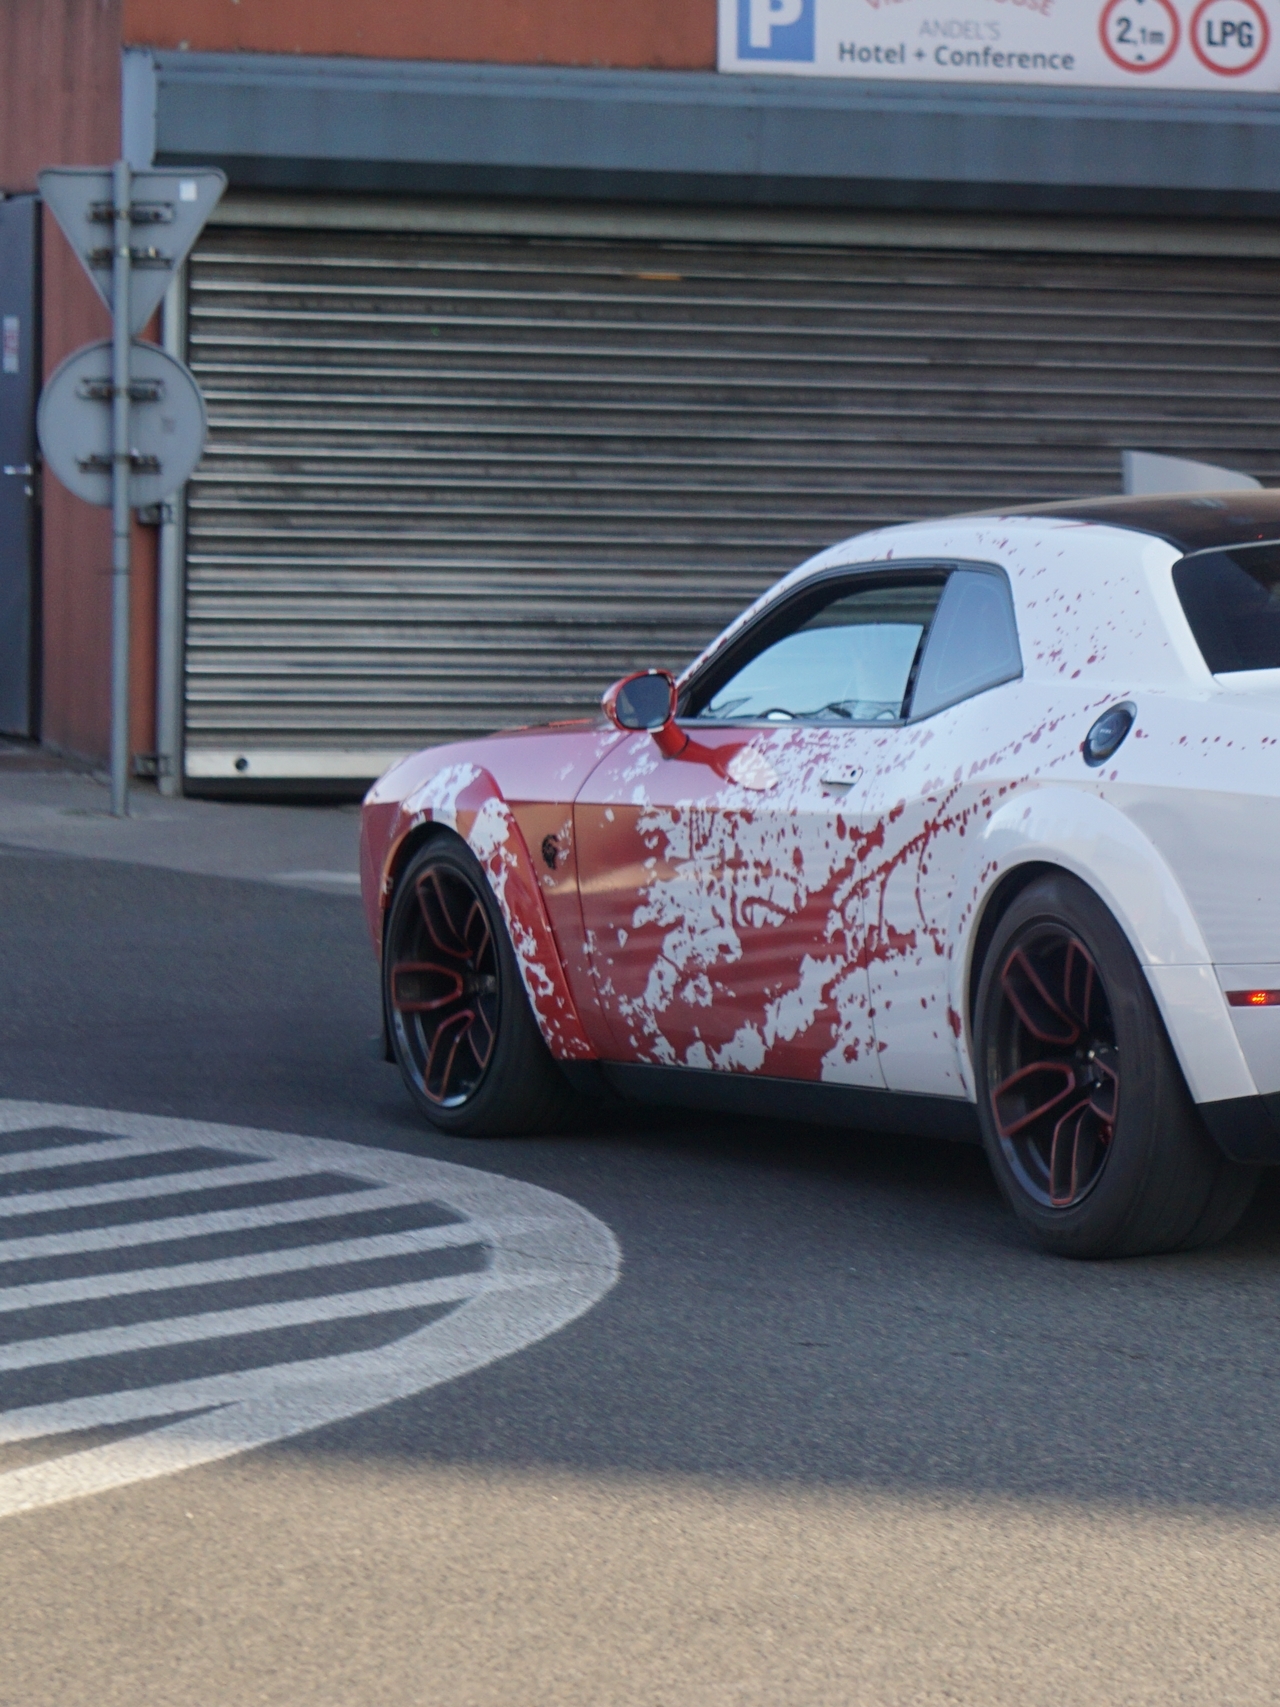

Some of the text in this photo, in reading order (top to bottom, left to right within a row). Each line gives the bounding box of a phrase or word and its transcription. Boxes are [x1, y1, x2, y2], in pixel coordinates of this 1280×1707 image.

[748, 0, 803, 48] P
[919, 19, 1002, 41] ANDEL'S
[1206, 20, 1254, 48] LPG
[838, 42, 1076, 71] Hotel + Conference
